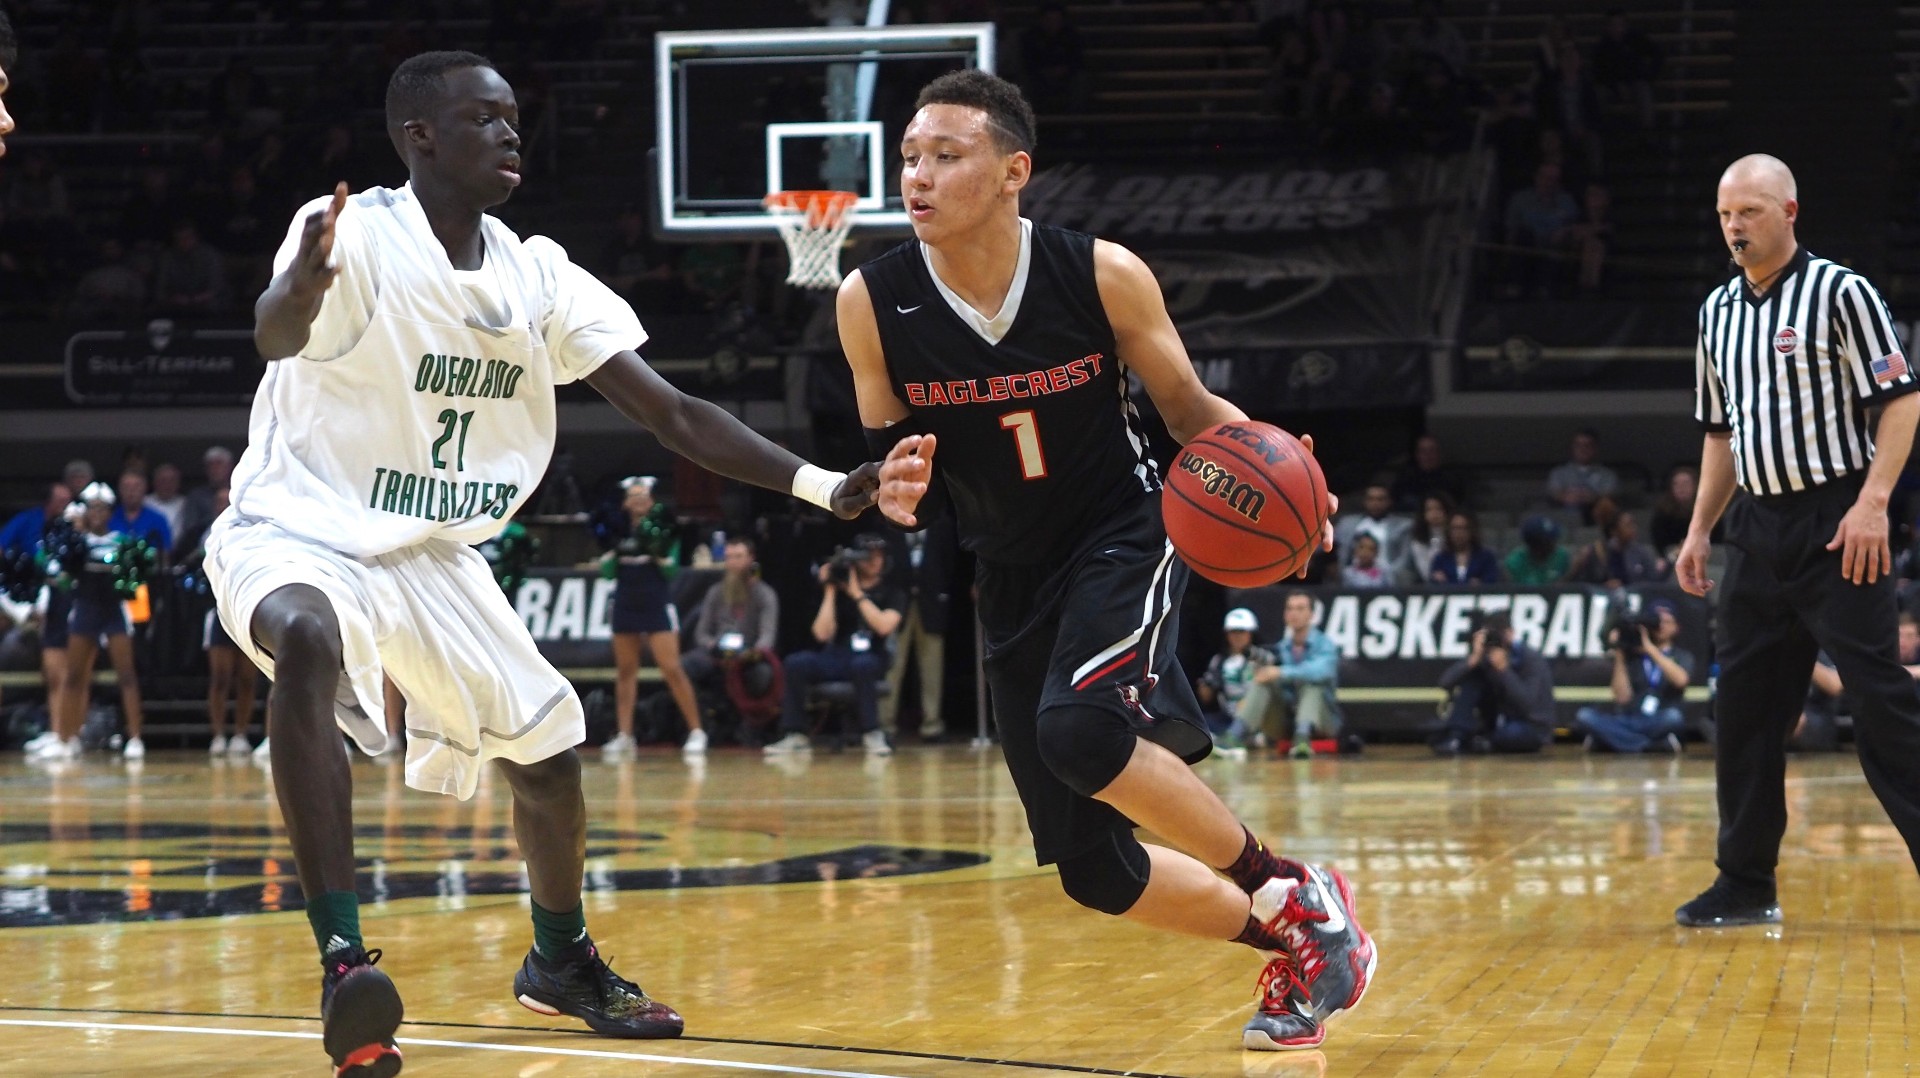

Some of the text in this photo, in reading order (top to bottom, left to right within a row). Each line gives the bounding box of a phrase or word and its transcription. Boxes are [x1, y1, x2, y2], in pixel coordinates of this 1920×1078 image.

[1022, 164, 1394, 206] LORADO
[414, 353, 524, 398] OVERLAND
[904, 353, 1103, 406] EAGLECREST
[431, 408, 475, 472] 21
[999, 409, 1048, 480] 1
[1214, 425, 1287, 465] NCAA
[1178, 451, 1266, 523] Wilson
[515, 578, 618, 639] RAD
[1283, 593, 1642, 659] ASKEBAL
